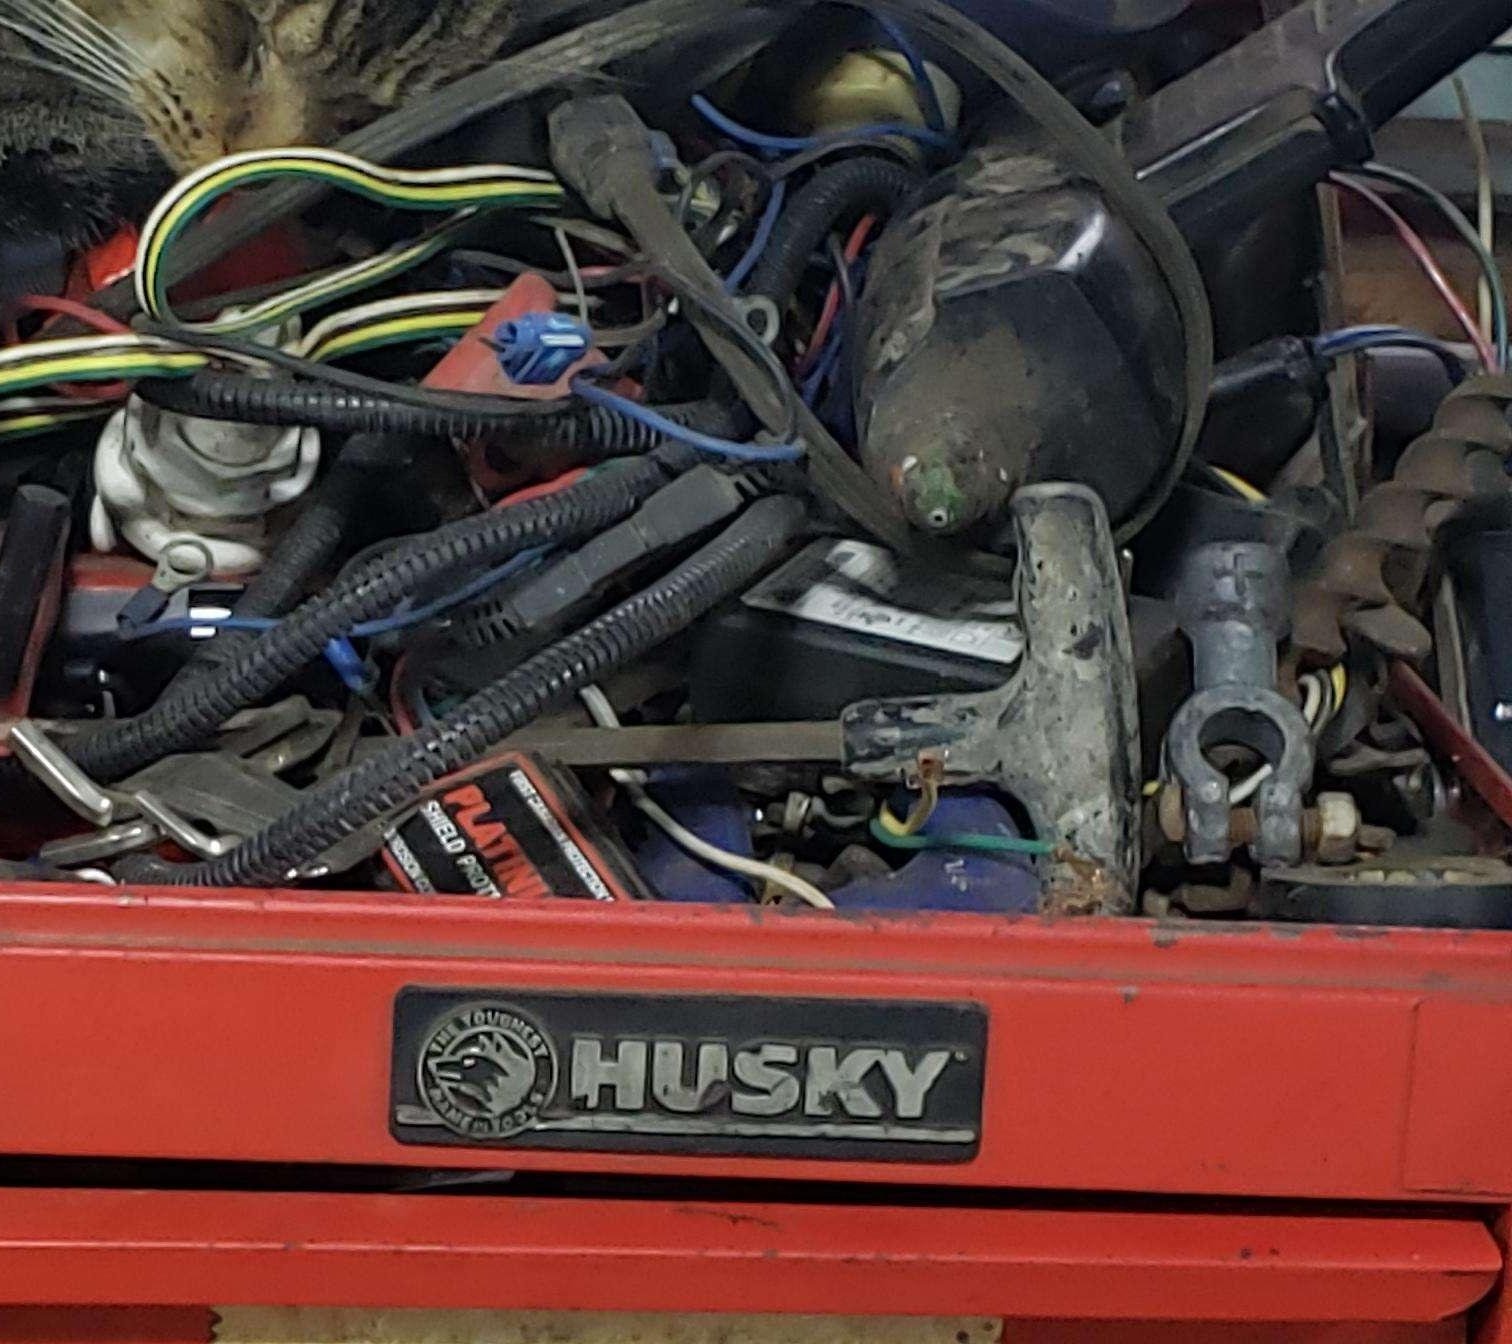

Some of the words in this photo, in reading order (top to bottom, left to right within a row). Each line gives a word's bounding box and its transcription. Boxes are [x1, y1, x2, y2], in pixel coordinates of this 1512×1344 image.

[420, 800, 466, 854] SHIELD
[462, 1010, 549, 1057] TOUGHEST
[570, 1038, 951, 1119] HUSKY
